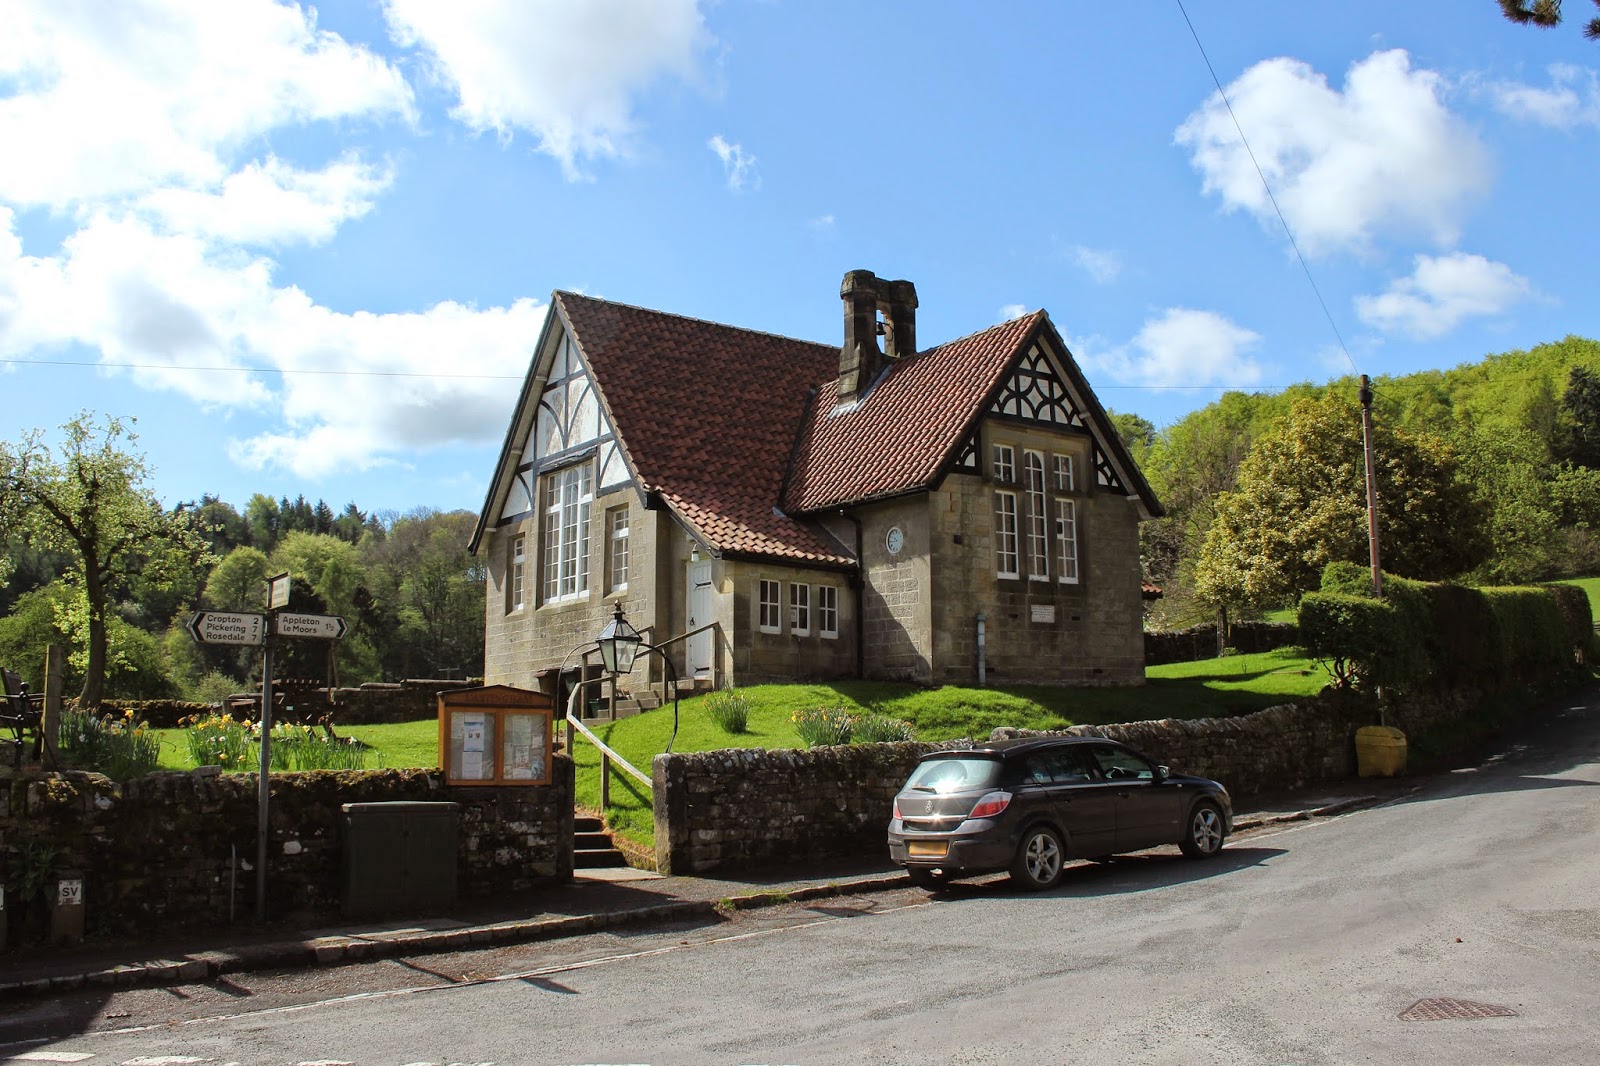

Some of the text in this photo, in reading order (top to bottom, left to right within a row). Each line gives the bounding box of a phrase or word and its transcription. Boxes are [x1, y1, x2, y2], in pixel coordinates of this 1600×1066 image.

[207, 614, 259, 625] Cropton 2
[282, 616, 320, 625] Appleton
[206, 623, 258, 634] Pickering 7
[292, 625, 317, 633] Moors
[206, 632, 257, 642] Rosedale 7
[62, 887, 79, 897] SV
